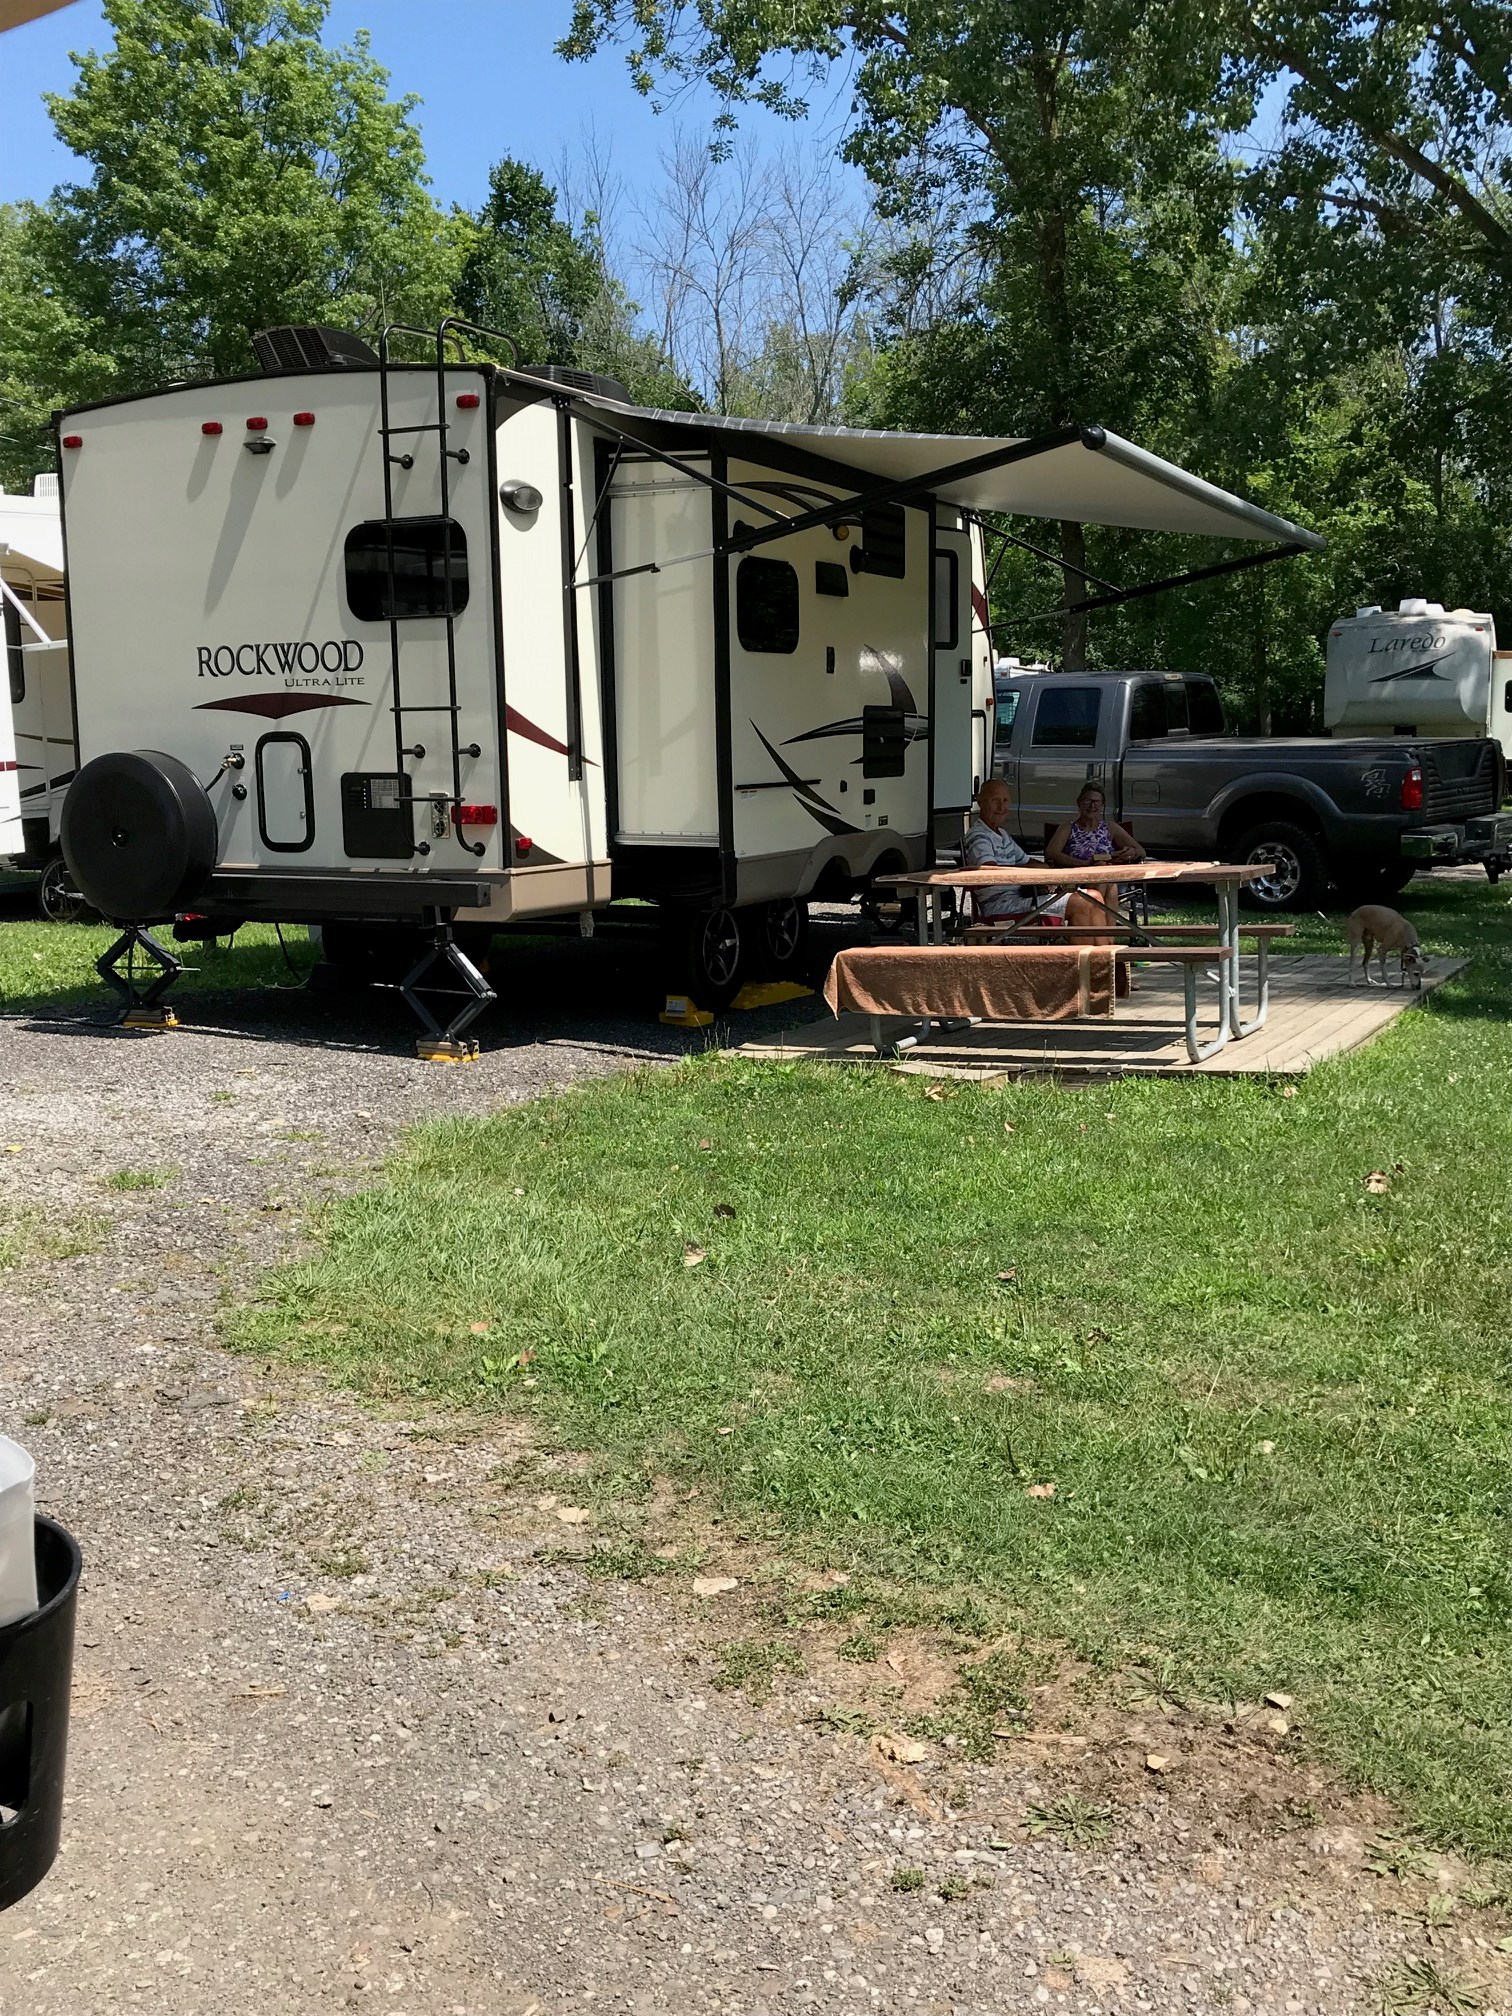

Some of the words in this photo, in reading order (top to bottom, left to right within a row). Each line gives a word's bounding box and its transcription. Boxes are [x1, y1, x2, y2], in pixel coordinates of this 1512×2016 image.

[1367, 632, 1446, 654] Laredo
[196, 640, 364, 678] ROCKWOOD
[284, 677, 331, 687] ULTRA
[335, 677, 365, 686] LITE
